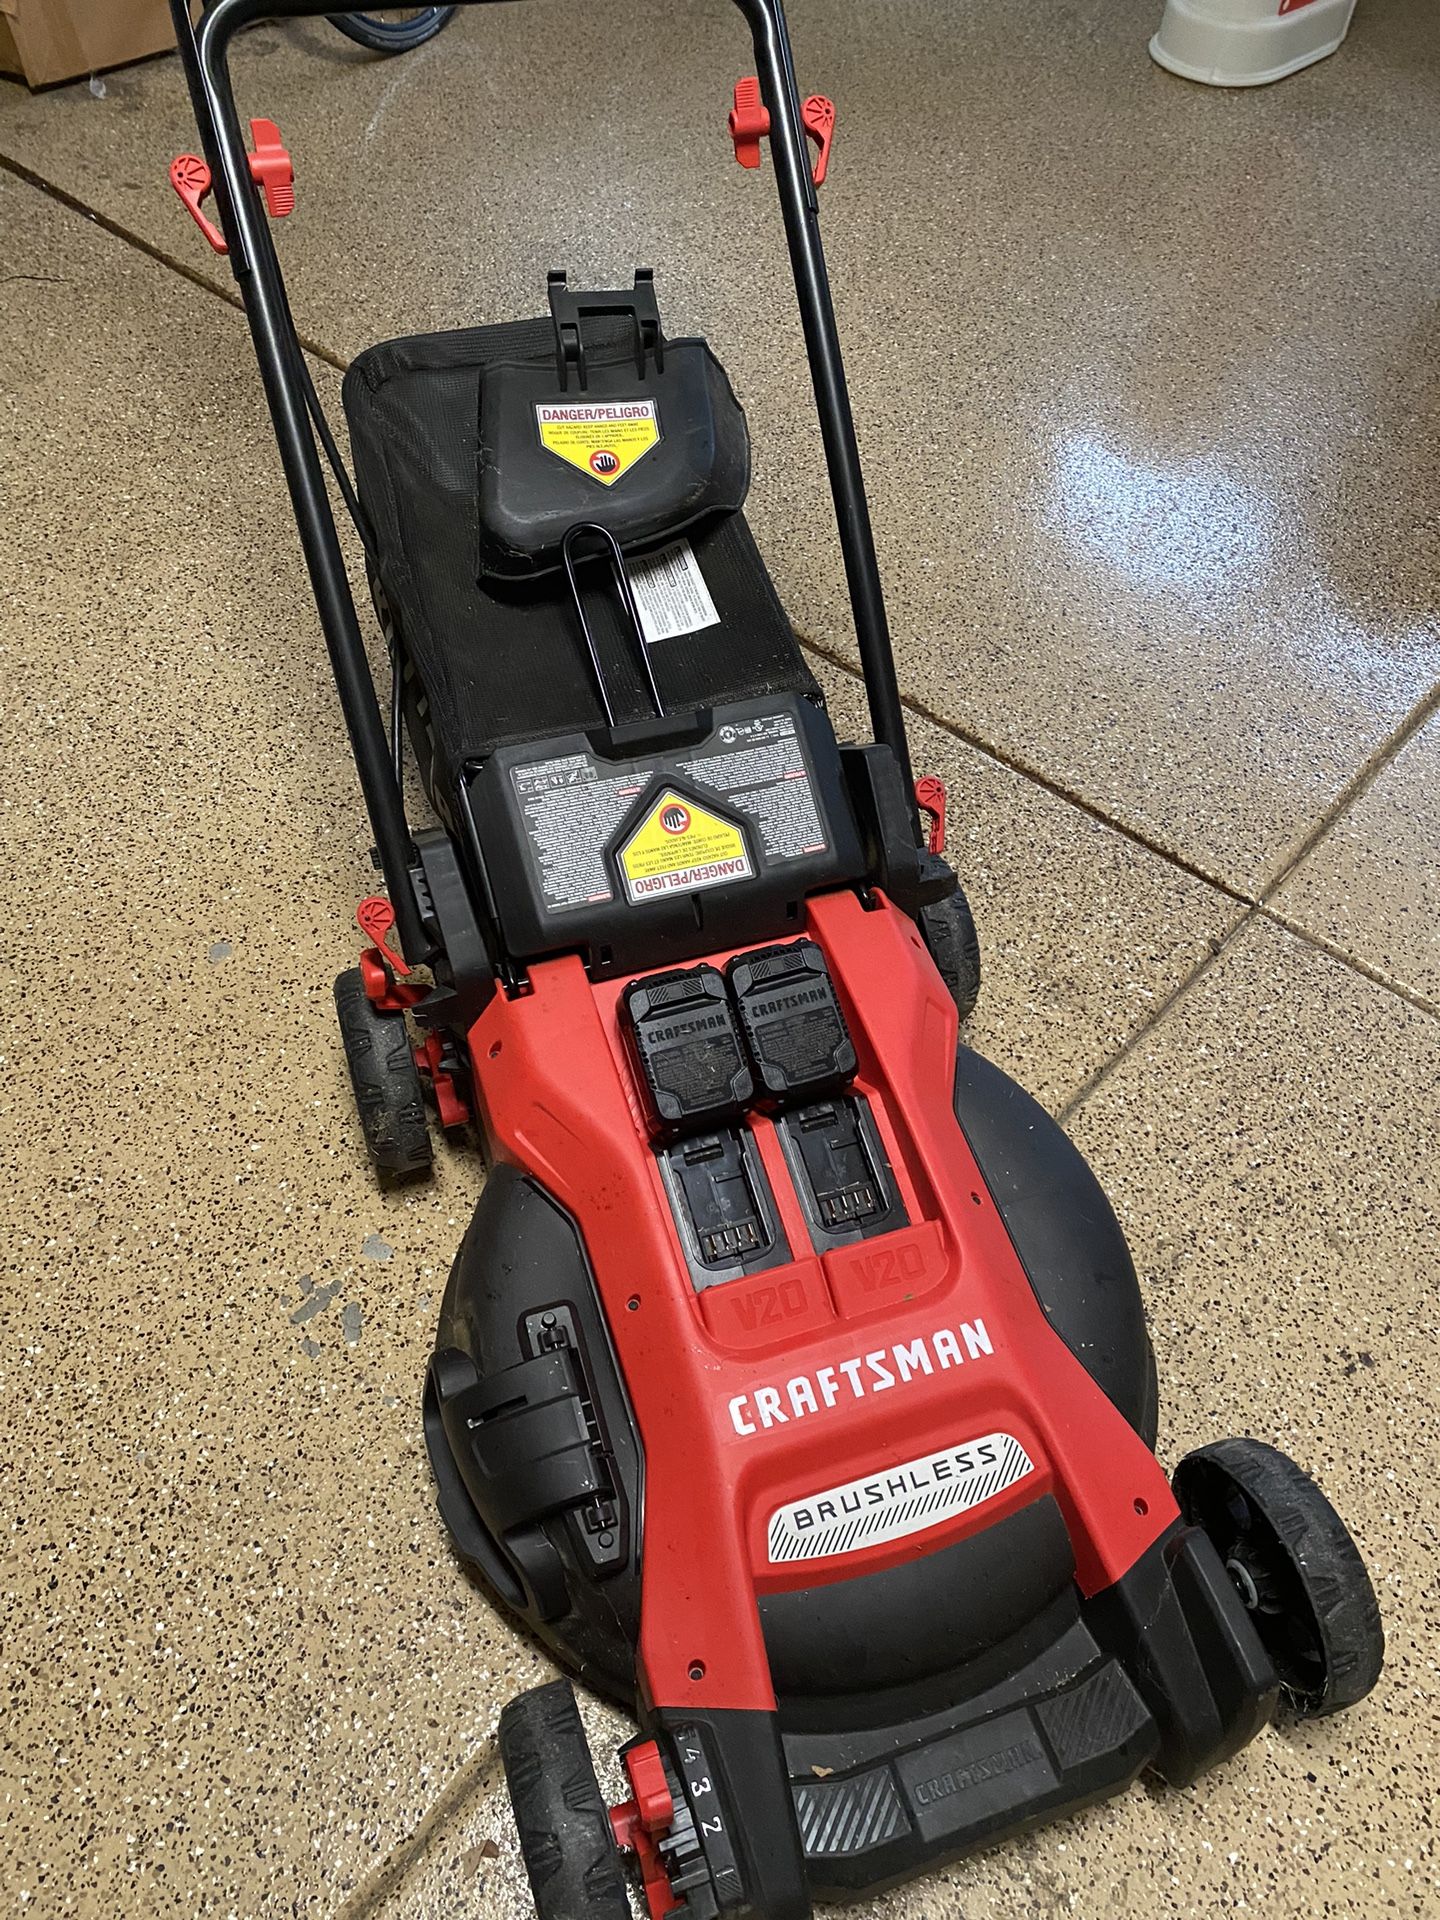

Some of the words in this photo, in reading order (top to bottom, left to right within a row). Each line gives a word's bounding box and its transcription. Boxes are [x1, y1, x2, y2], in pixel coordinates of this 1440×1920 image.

[542, 405, 649, 421] DANGER/PELIGRO
[635, 859, 745, 894] DANGER/PELIGRO
[752, 986, 828, 1019] CRAFTSMAN
[647, 1013, 727, 1044] CRAFTSMAN
[850, 1242, 928, 1294] V20
[729, 1278, 809, 1331] V20
[728, 1318, 995, 1436] CRAFTSMAN
[793, 1443, 998, 1531] BRUSHLESS
[684, 1748, 701, 1765] 4
[691, 1776, 711, 1798] 3
[701, 1815, 723, 1838] 2
